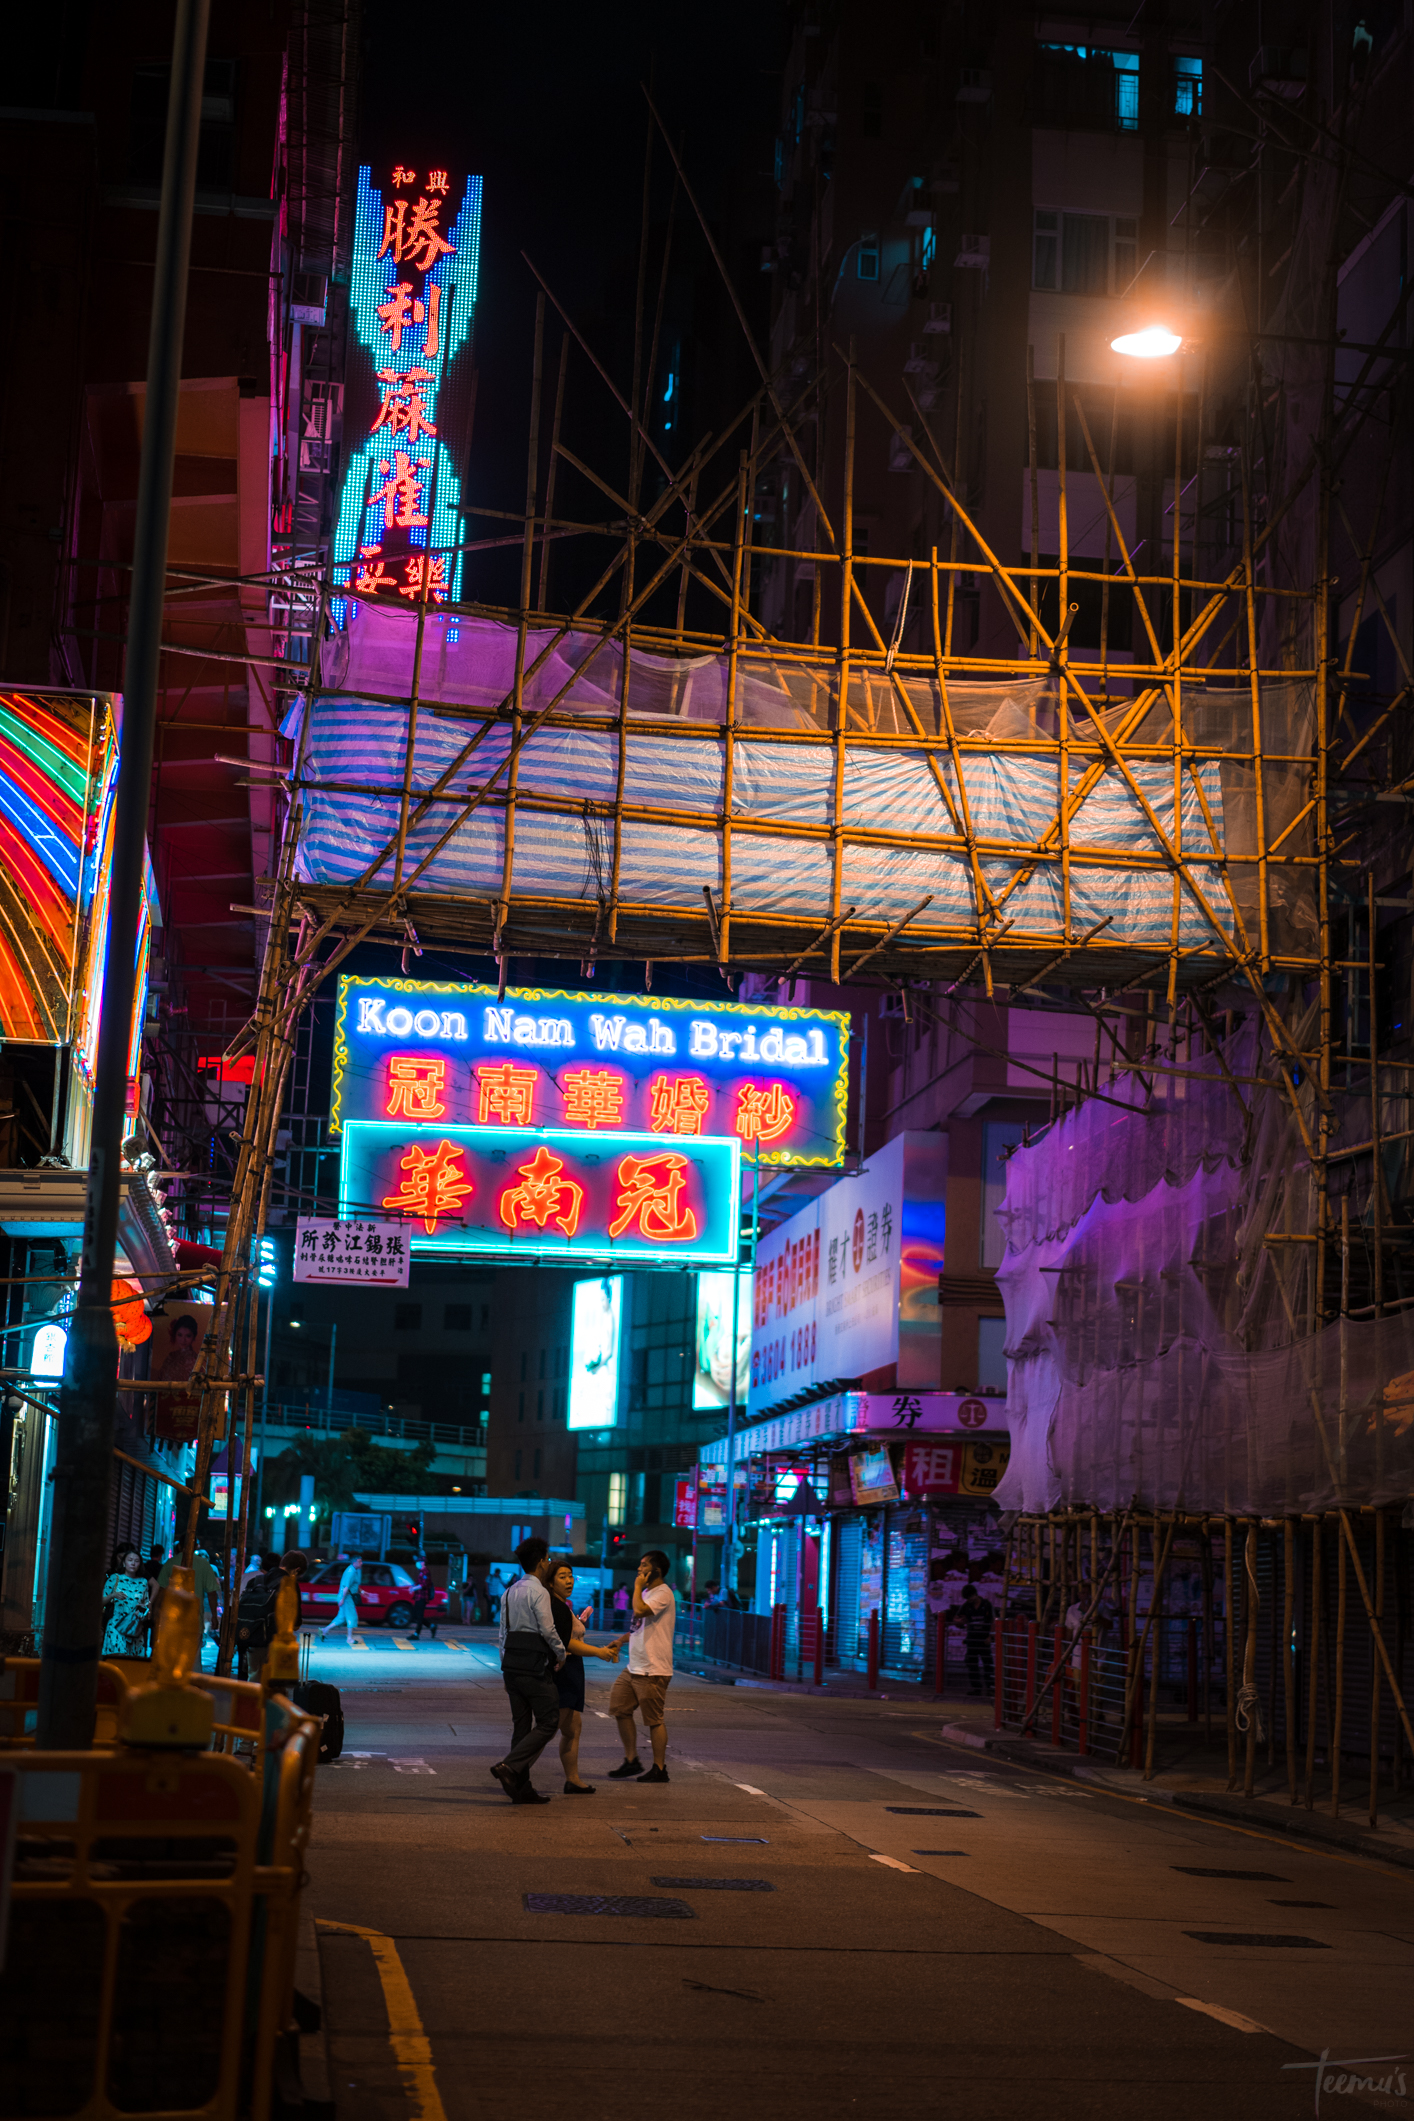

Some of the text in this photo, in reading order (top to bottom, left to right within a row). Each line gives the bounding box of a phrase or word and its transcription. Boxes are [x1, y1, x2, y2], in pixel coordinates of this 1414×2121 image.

[357, 998, 829, 1064] Koon Nam Wah Bridal
[386, 1056, 793, 1141] 冠南華婚紗
[912, 1448, 953, 1486] 租
